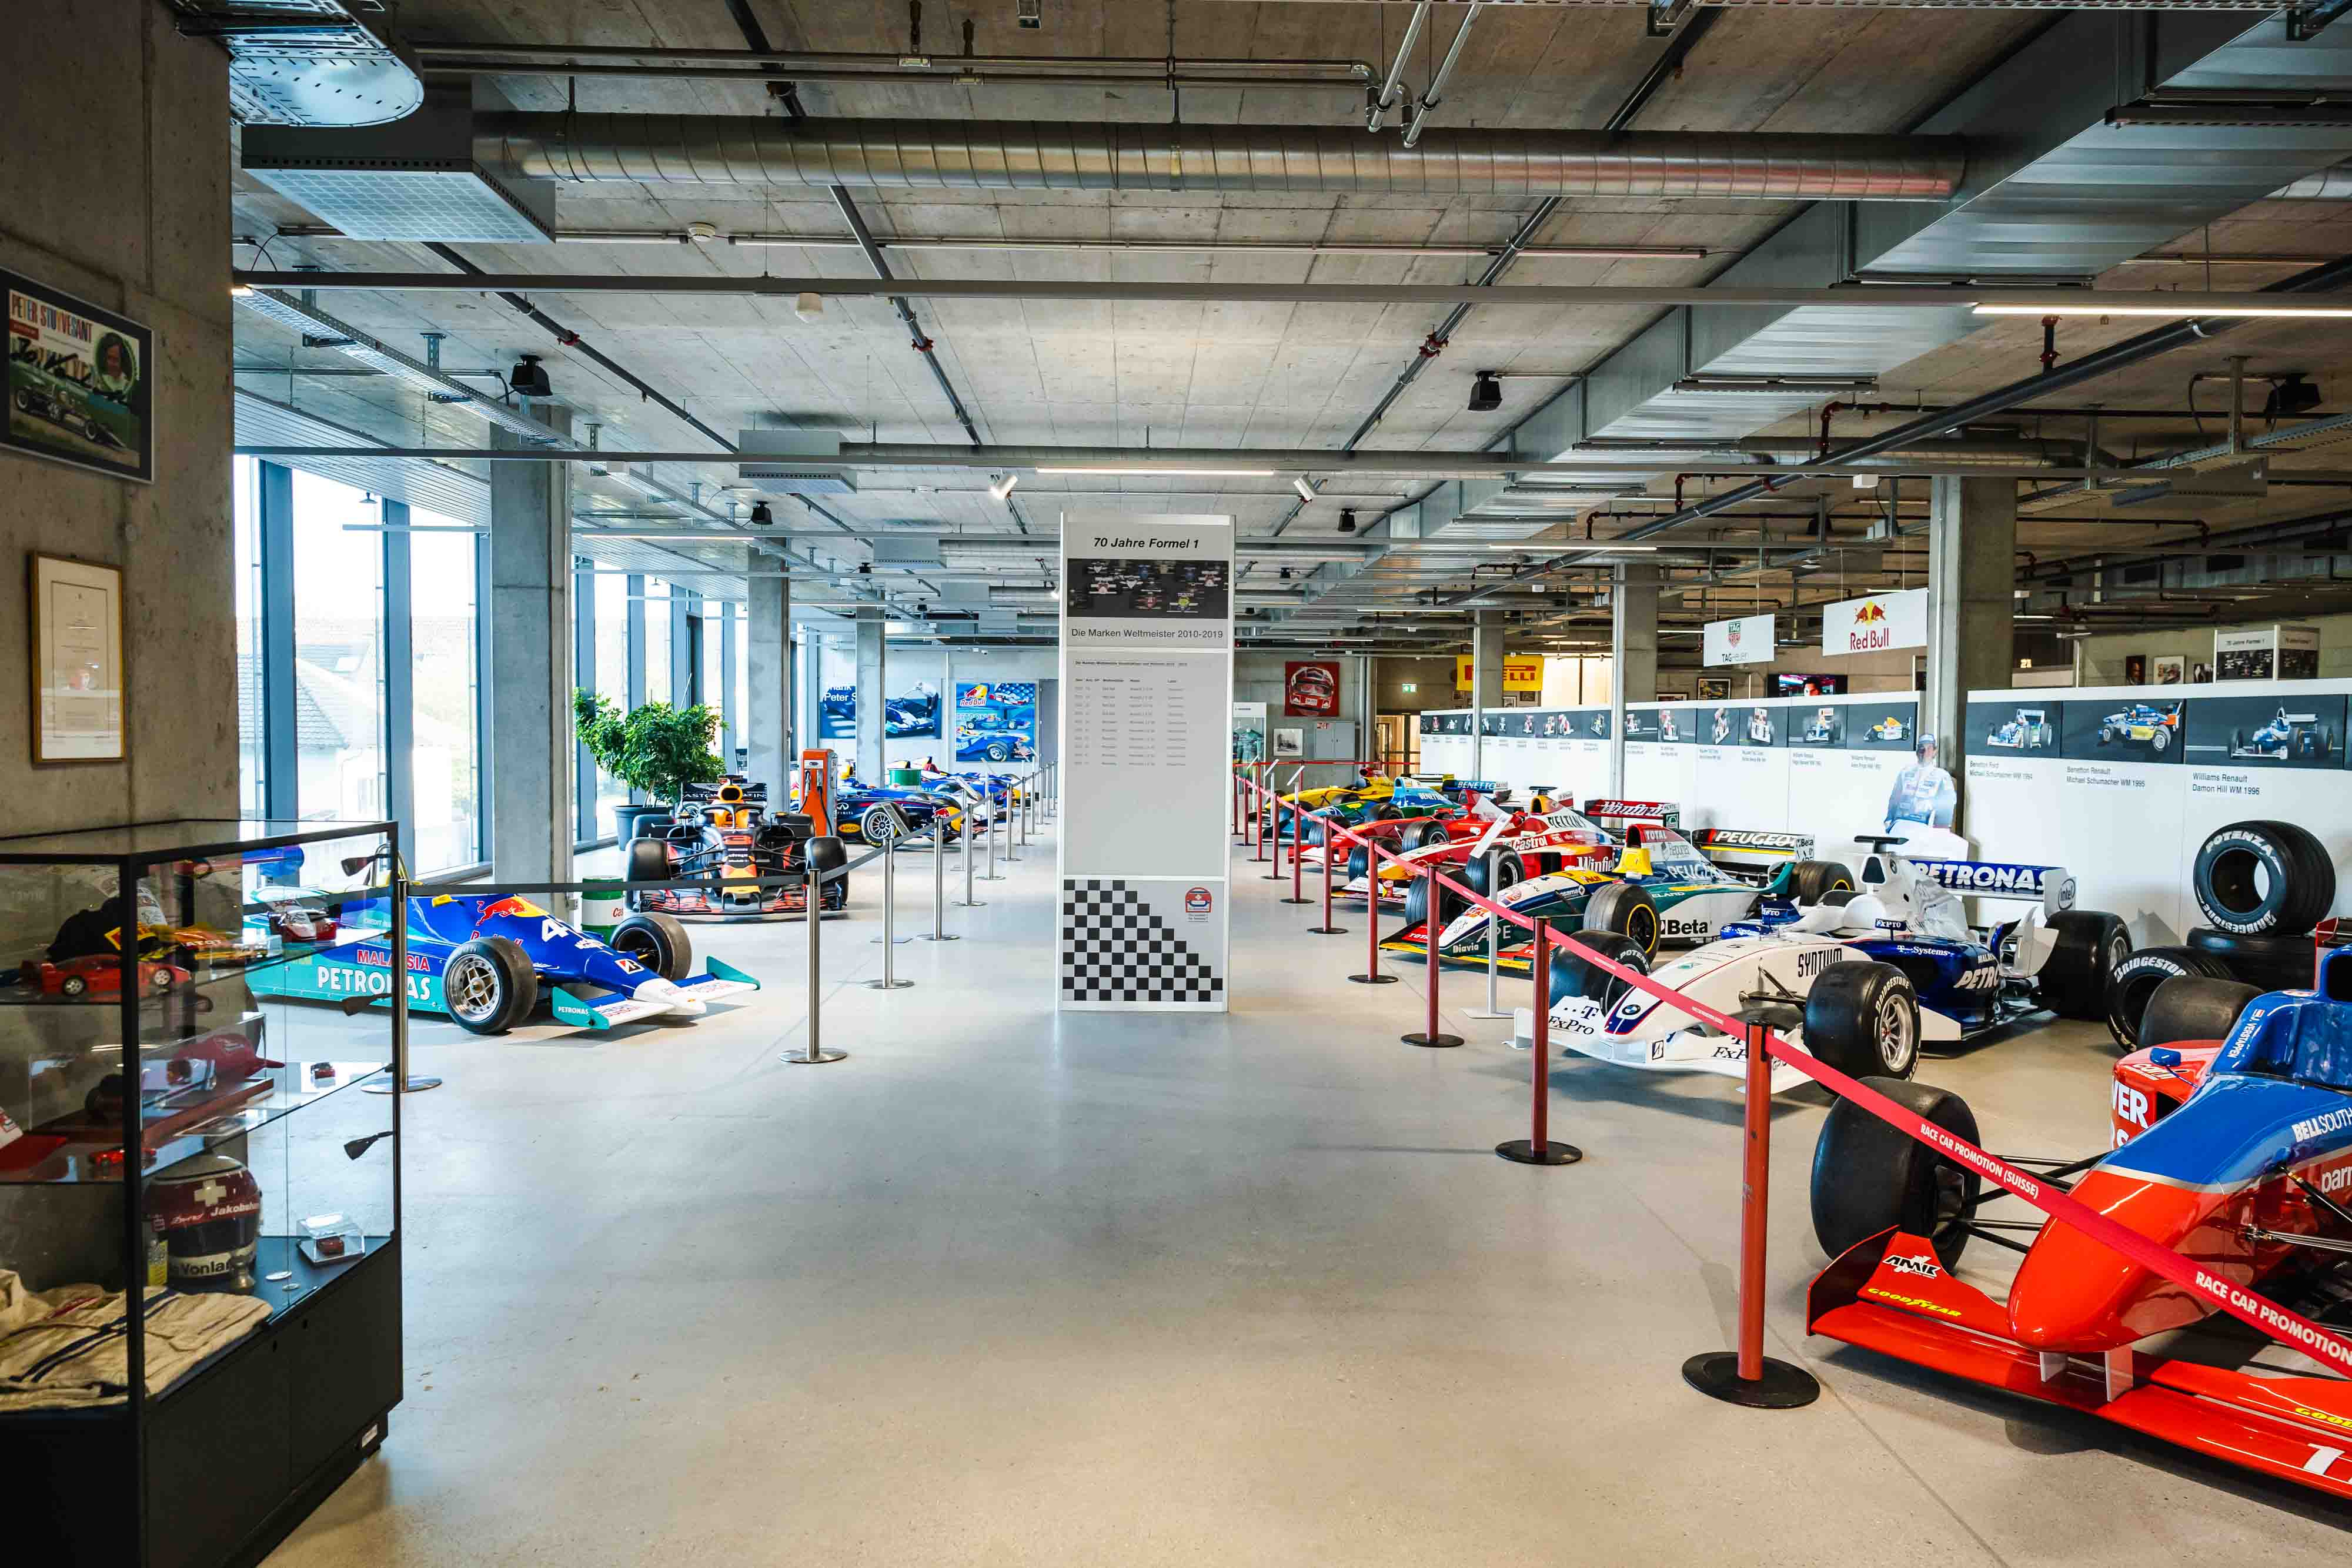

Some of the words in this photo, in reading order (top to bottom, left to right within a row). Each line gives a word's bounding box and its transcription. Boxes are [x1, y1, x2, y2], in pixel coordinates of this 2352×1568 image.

[12, 295, 38, 323] PETER
[41, 305, 93, 344] STUYVESANT
[1093, 537, 1108, 547] 70
[1110, 537, 1145, 548] Jahre
[1148, 538, 1190, 549] Formel
[1193, 539, 1200, 549] 1
[1071, 628, 1086, 637] Die
[1088, 628, 1121, 637] Marken
[1123, 629, 1175, 638] Weltmeister
[1177, 630, 1223, 638] 2010-2019
[1849, 629, 1867, 650] Red
[1870, 627, 1889, 648] Bull
[824, 692, 849, 701] Peter
[2086, 777, 2120, 786] Schumacher
[2193, 772, 2220, 781] Williams
[2221, 774, 2248, 783] Renault
[2192, 784, 2215, 792] Damon
[2217, 785, 2227, 793] Hill
[2229, 785, 2242, 794] WM
[2244, 787, 2260, 795] 1996
[1512, 836, 1548, 850] Castrol
[1644, 830, 1666, 840] TOTAL
[2205, 830, 2274, 857] POTENZA
[2059, 887, 2072, 901] intel
[1668, 918, 1709, 935] Beta
[2202, 903, 2277, 934] BRIDGESTONE
[542, 918, 569, 943] 4
[1452, 943, 1479, 954] Diavia
[357, 949, 430, 972] MALASIA
[317, 965, 430, 1001] PETROAS
[557, 1006, 589, 1015] PETRONAS
[1548, 1015, 1595, 1035] FxPro
[2227, 1023, 2257, 1059] VERSTAPPEN
[2291, 1107, 2352, 1143] BELLSOUTH
[1920, 1123, 1938, 1141] RACE
[1939, 1134, 1953, 1150] CAR
[1954, 1142, 2003, 1178] PROMOTION
[2003, 1169, 2039, 1200] (SUISSE)
[1867, 1288, 1962, 1318] GOODYEAR
[2195, 1271, 2229, 1299] RACE
[2230, 1290, 2258, 1315] CAR
[2260, 1305, 2352, 1366] PROMOTION
